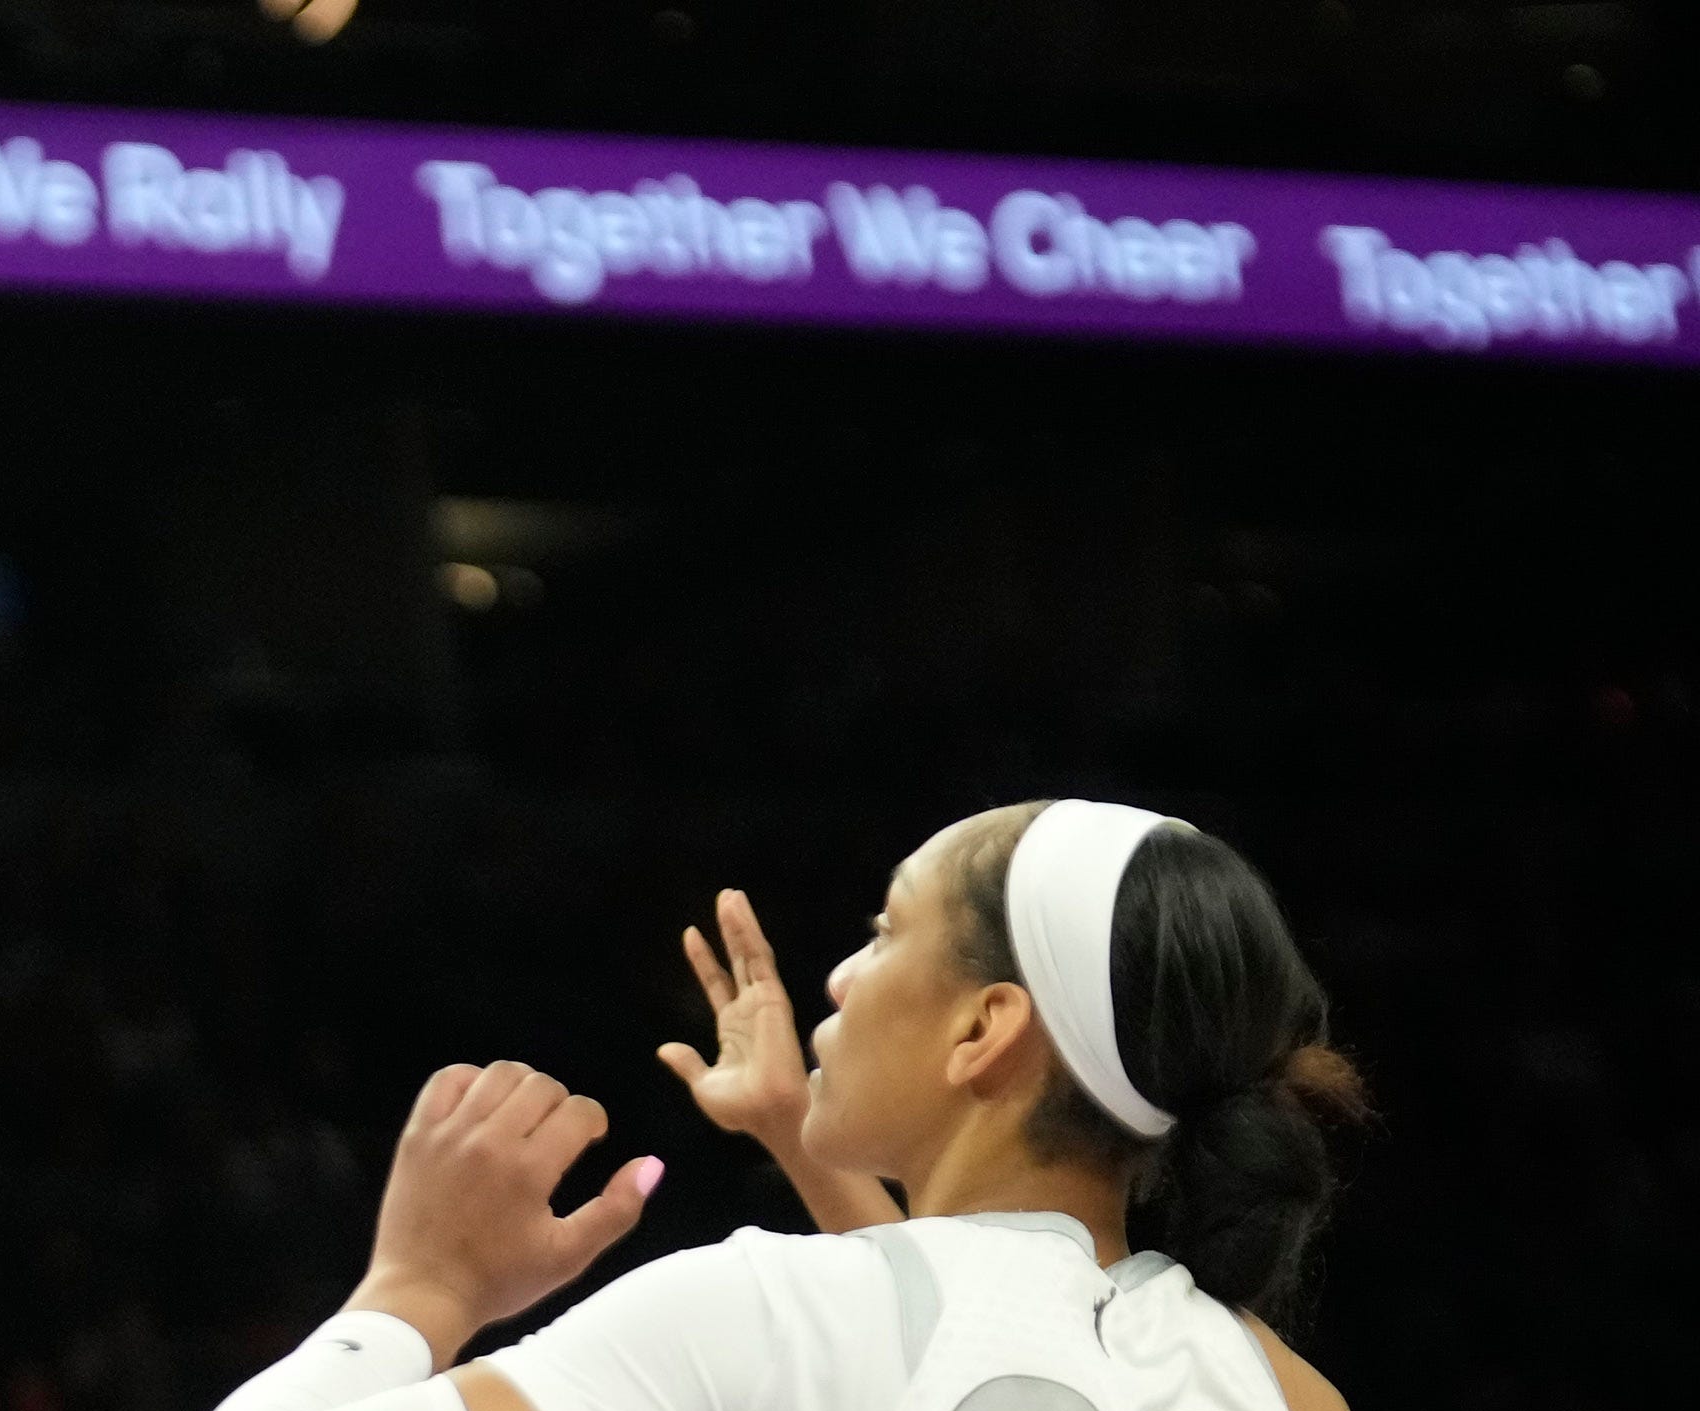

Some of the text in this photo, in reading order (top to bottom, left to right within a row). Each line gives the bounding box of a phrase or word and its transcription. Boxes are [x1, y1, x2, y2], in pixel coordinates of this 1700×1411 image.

[101, 141, 346, 280] Rally
[416, 160, 1256, 304] Together We Cheer
[1319, 224, 1689, 348] Together
